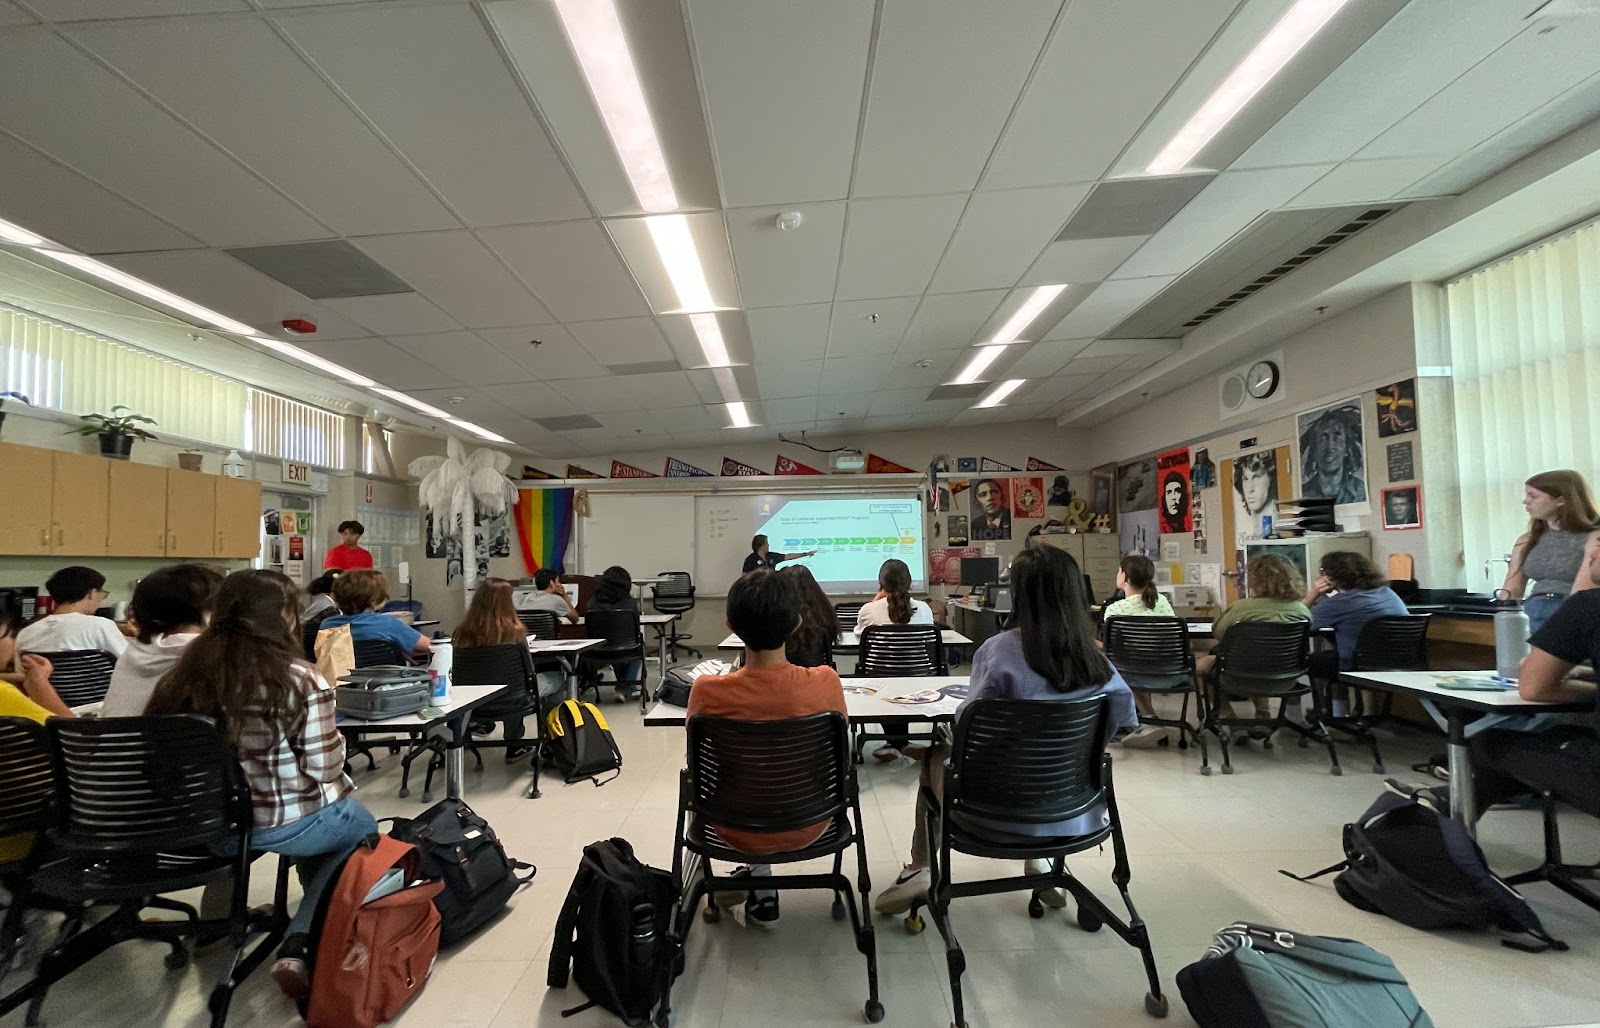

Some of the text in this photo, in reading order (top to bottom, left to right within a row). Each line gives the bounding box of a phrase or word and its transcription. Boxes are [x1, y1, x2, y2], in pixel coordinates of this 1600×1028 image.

[668, 459, 689, 471] FRESNO
[982, 459, 1011, 471] GEORGETOWN
[288, 464, 308, 481] EXIT
[620, 466, 654, 477] STANFORD
[973, 528, 1010, 538] HOPE
